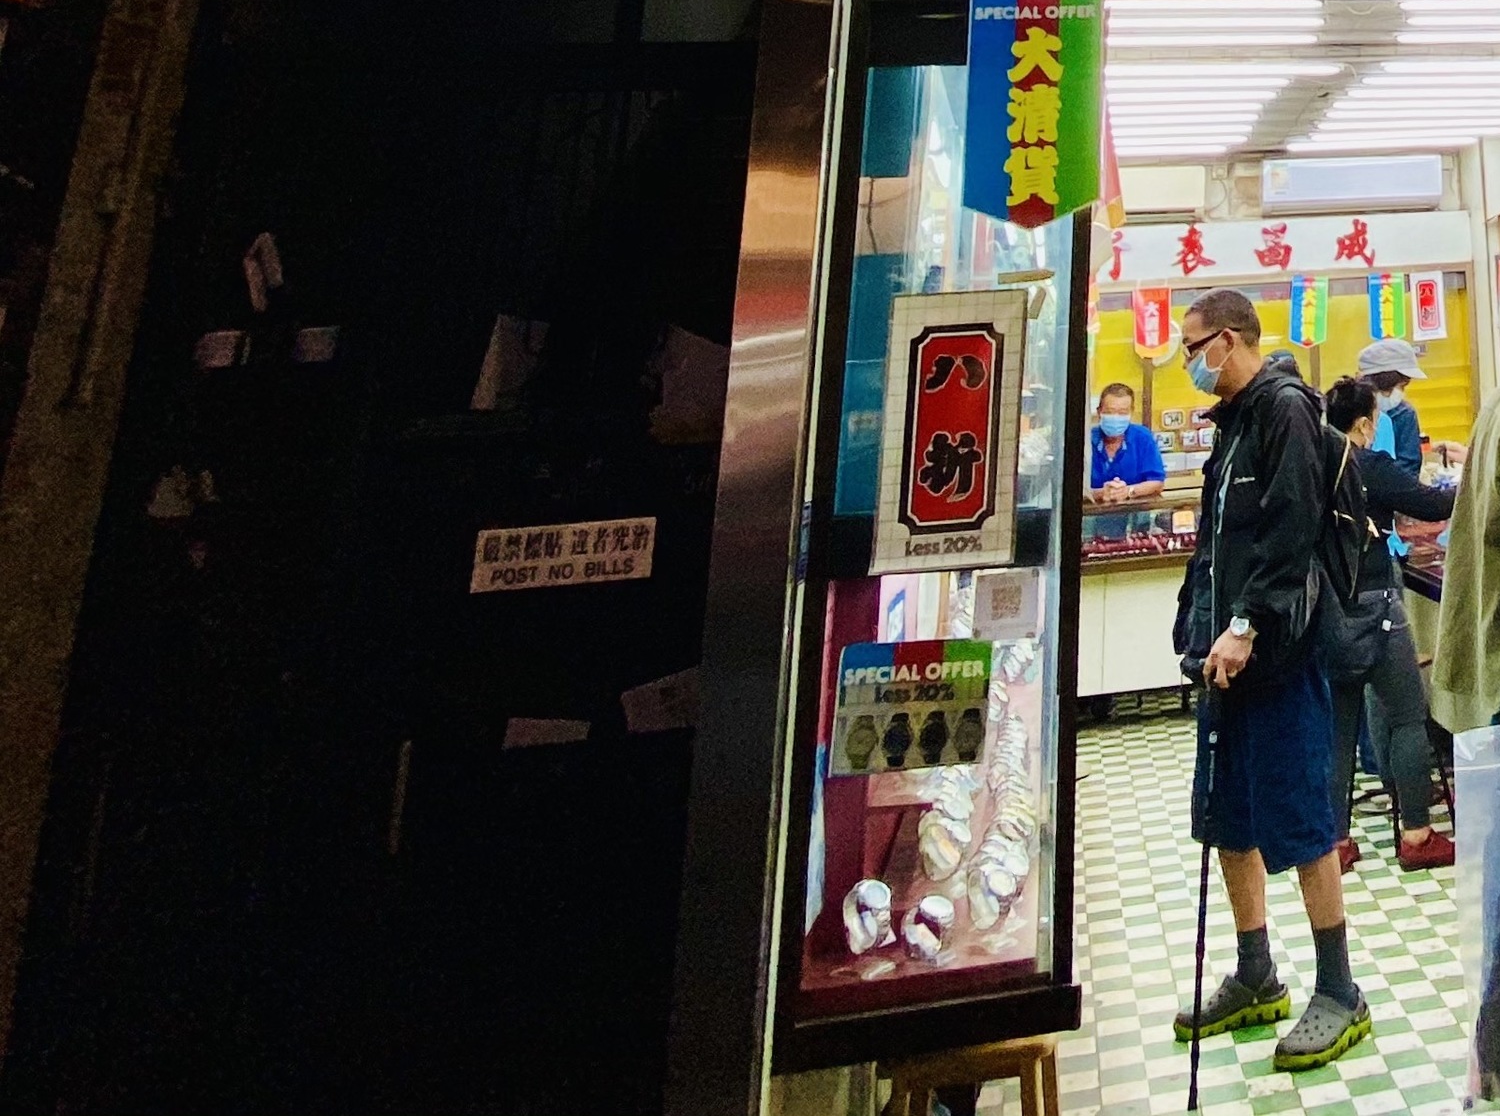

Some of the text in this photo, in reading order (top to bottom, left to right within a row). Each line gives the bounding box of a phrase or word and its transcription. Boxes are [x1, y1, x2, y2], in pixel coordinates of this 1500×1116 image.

[974, 4, 1097, 21] SPECIAL OFFER
[1003, 26, 1064, 207] 大清貨
[918, 354, 989, 503] 八折
[905, 536, 983, 557] Less 20%
[491, 558, 636, 585] POST NO BILLS
[844, 660, 985, 685] SPECIAL OFFER
